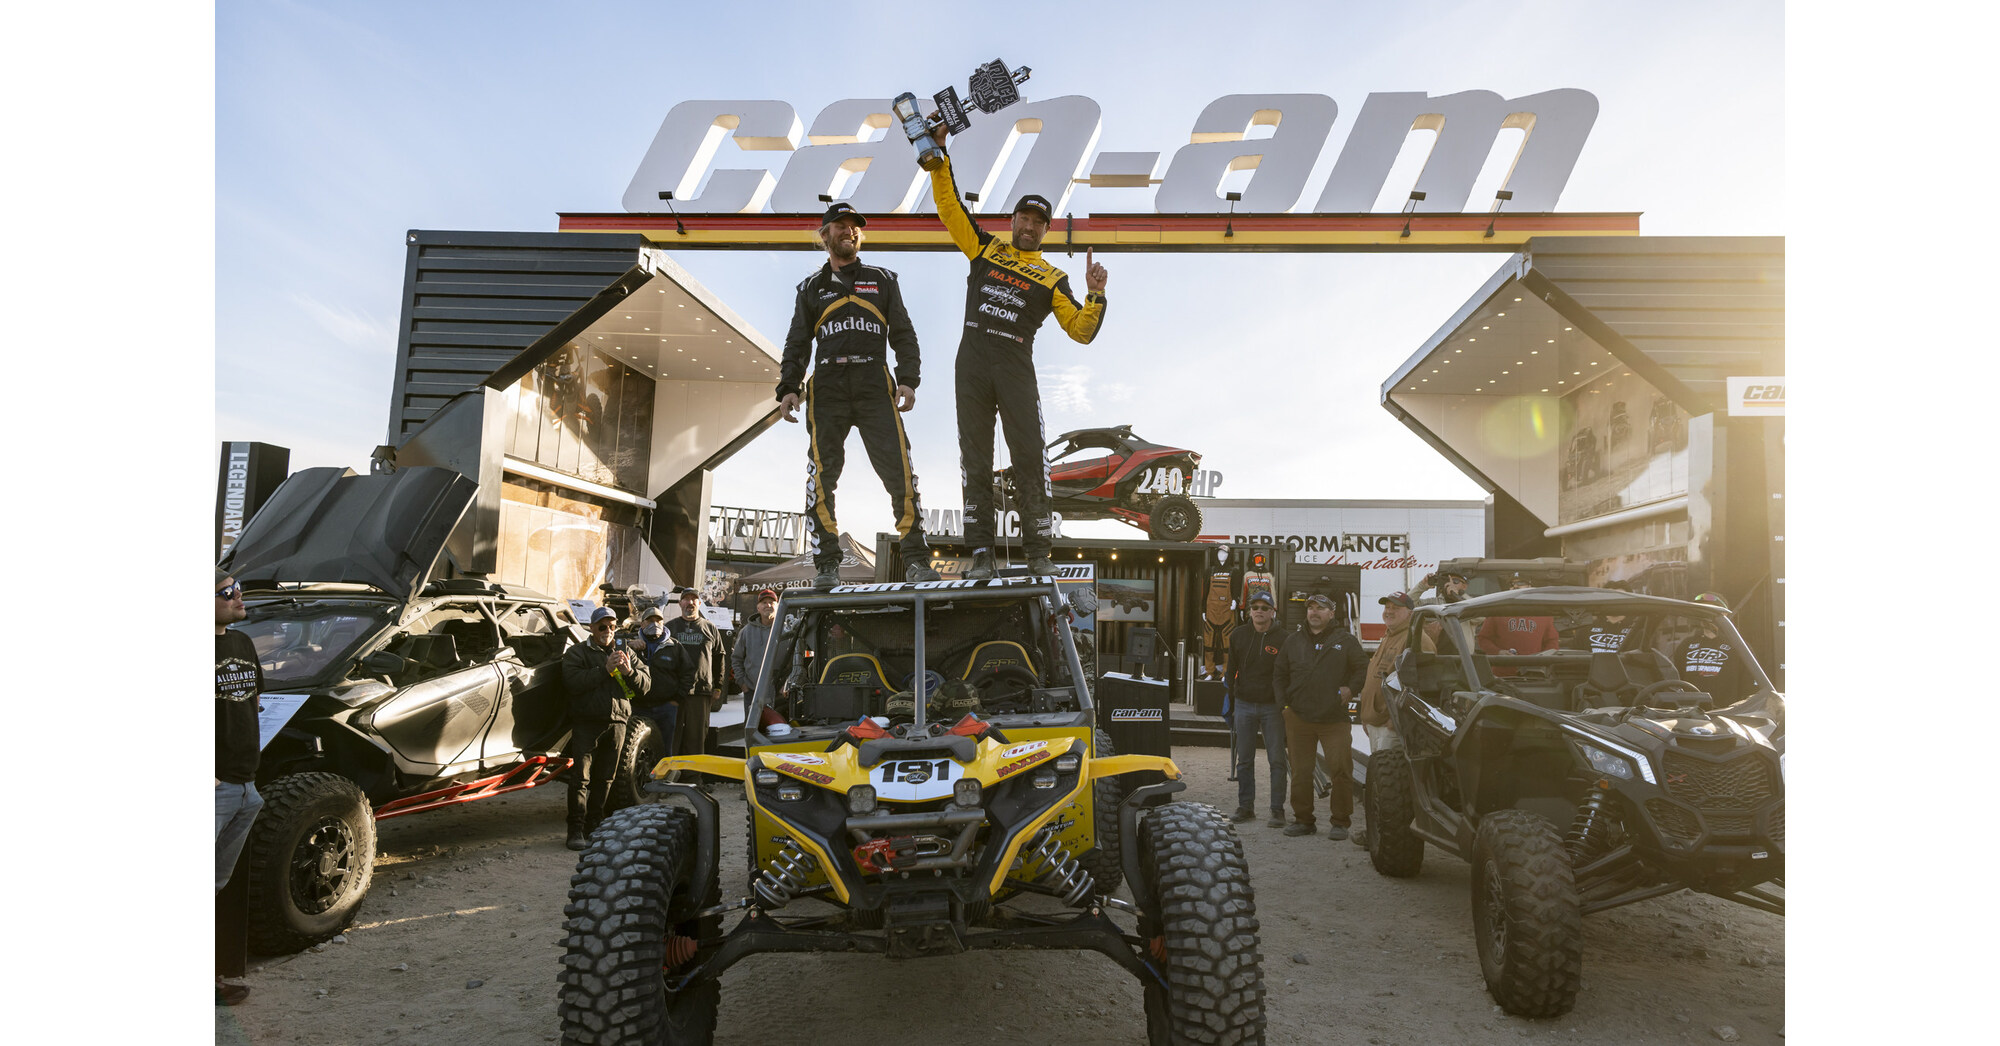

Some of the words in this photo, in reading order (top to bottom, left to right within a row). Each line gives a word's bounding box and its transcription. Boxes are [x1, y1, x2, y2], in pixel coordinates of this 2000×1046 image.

[940, 101, 954, 127] WINNER
[944, 97, 960, 124] OVERALL
[622, 88, 1599, 213] can-am
[988, 269, 1031, 291] MAXXIS
[1743, 385, 1785, 399] ca
[1137, 467, 1183, 494] 240
[1190, 469, 1223, 496] HP
[223, 452, 248, 539] LEGENDARY
[751, 582, 784, 592] DANG
[829, 579, 979, 594] can-am
[1508, 618, 1537, 632] GAP
[217, 670, 256, 683] ALLEGIANCE
[1112, 709, 1162, 717] can-am
[775, 763, 835, 785] MAXXIS
[880, 760, 950, 783] 191
[995, 750, 1051, 778] MAXXIS
